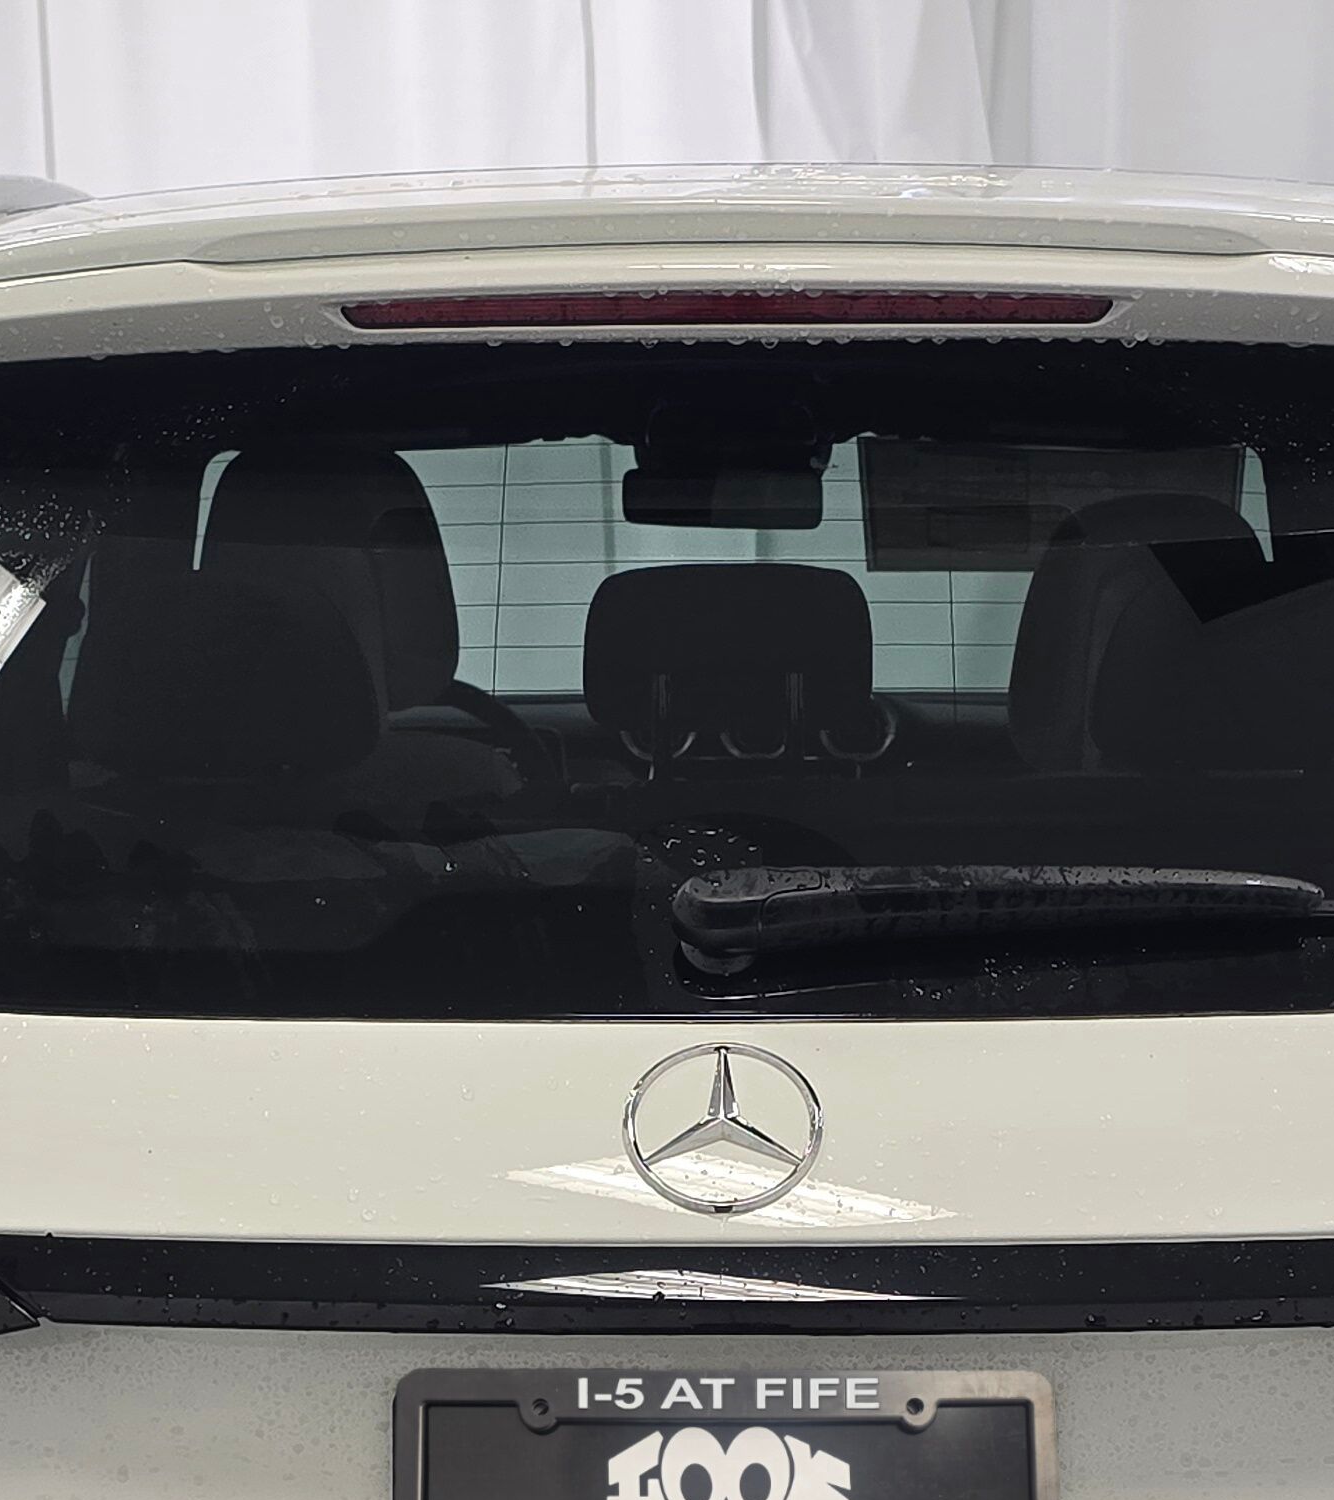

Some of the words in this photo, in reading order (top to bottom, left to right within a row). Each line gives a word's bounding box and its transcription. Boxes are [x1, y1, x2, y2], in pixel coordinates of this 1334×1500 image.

[577, 1377, 645, 1410] I-5
[659, 1377, 736, 1410] AT
[756, 1377, 881, 1411] FIFE
